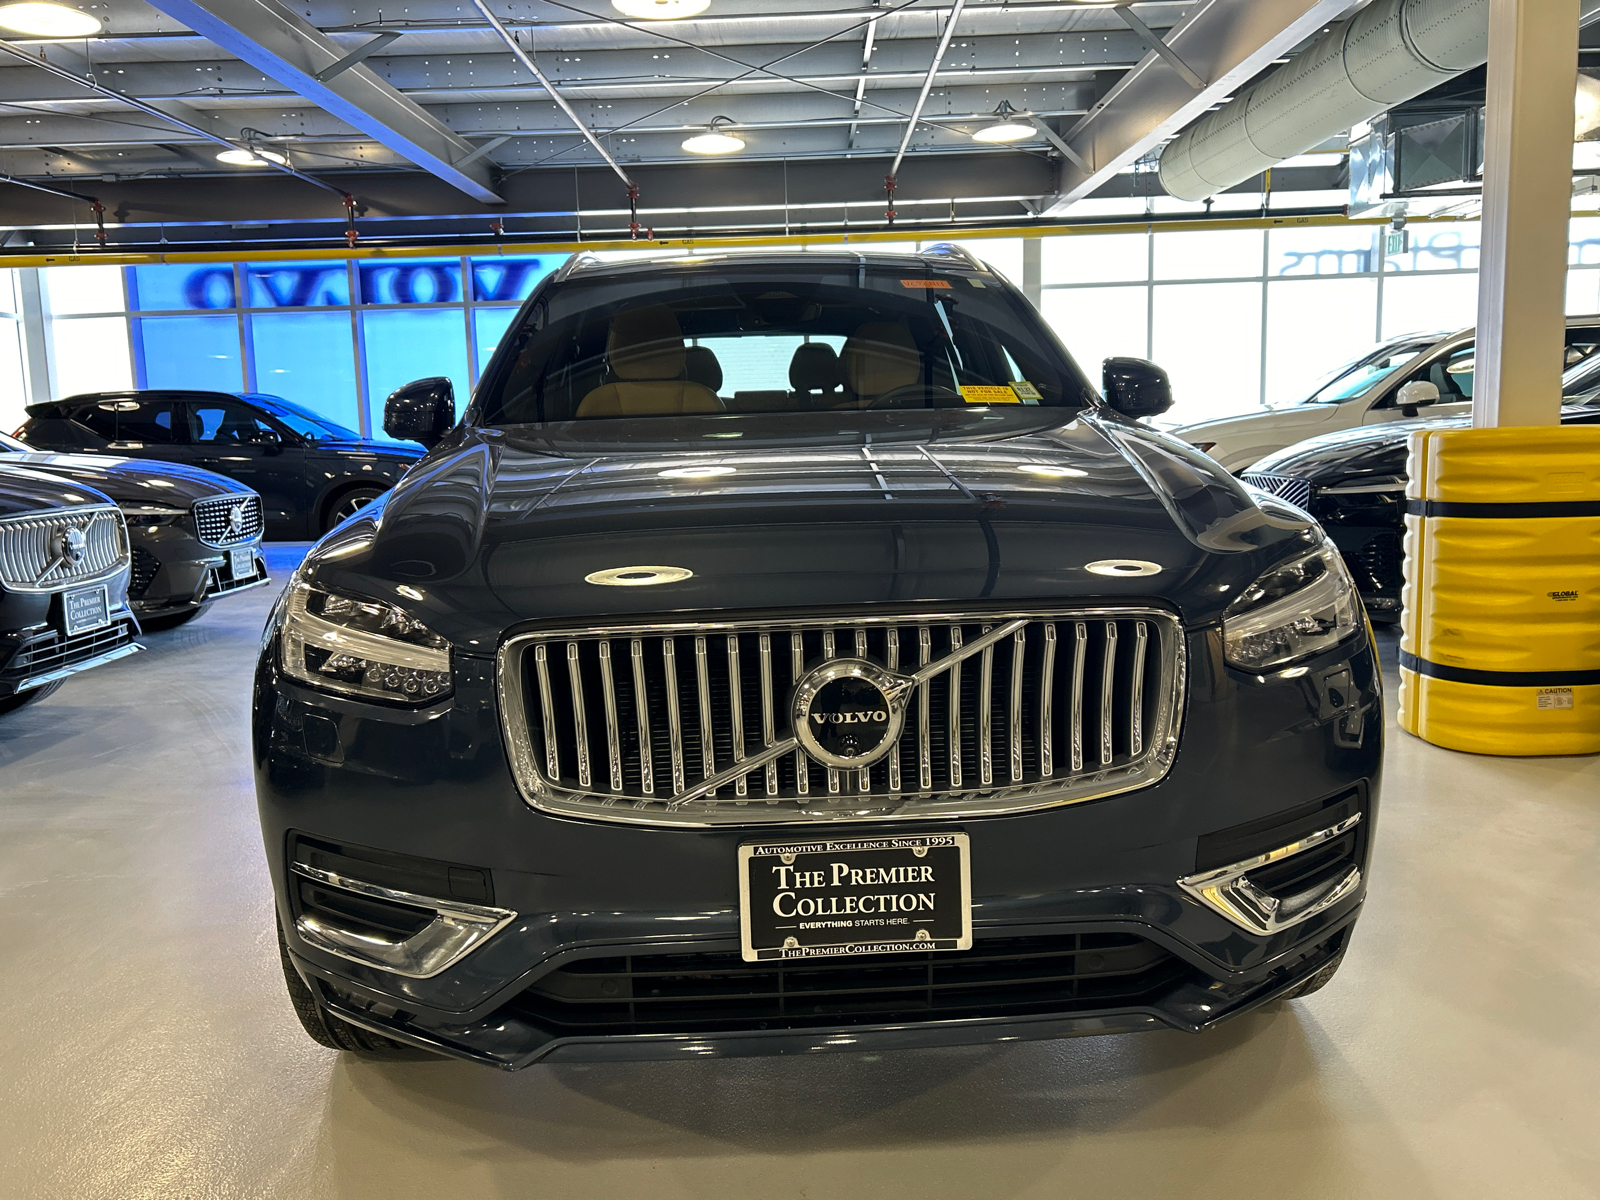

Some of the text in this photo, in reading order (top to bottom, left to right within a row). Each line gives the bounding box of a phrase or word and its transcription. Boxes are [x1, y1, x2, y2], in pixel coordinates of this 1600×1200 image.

[1388, 234, 1401, 254] EXIT
[811, 710, 887, 724] VOLVO
[756, 836, 954, 855] AUTOMOTIVE EXCELLENCE SINCE 1995
[772, 862, 935, 890] THE PREMIER
[772, 891, 935, 918] COLLECTION
[799, 917, 910, 930] EVERYTHING STARTS HERE.
